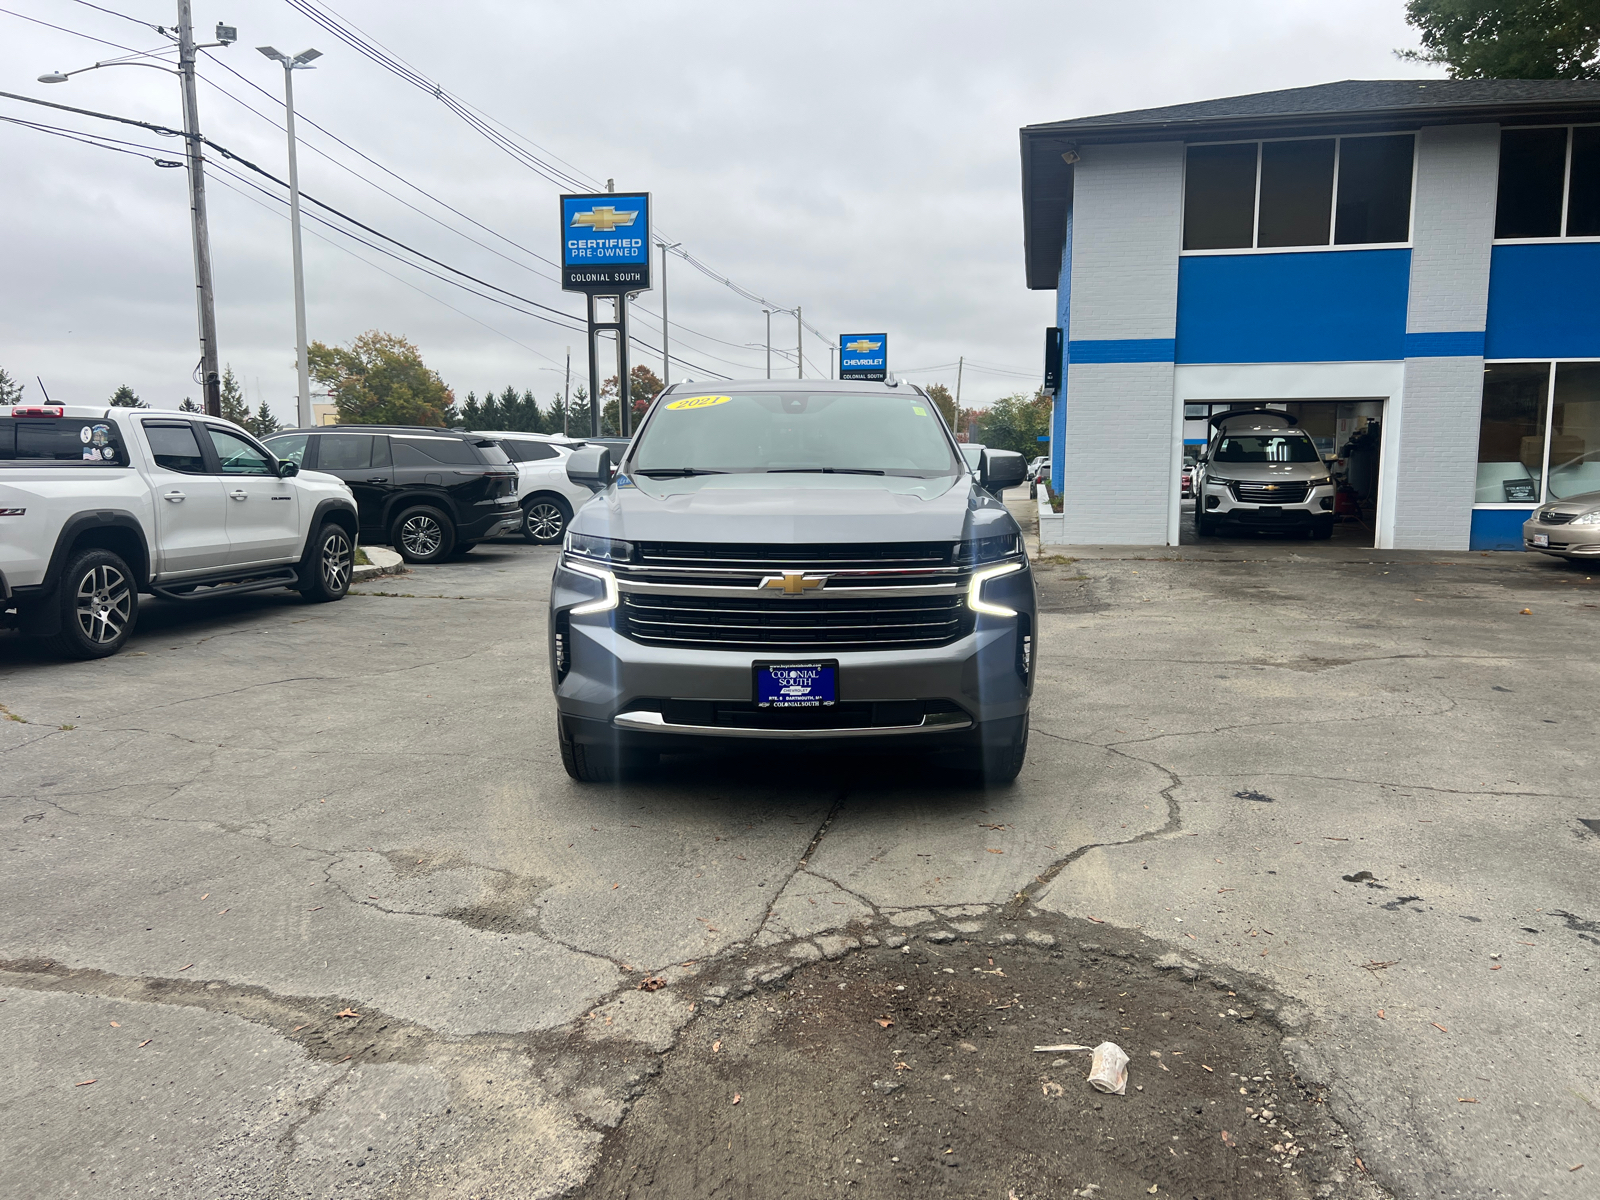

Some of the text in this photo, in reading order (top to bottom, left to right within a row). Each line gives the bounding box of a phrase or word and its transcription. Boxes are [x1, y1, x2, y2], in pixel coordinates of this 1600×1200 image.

[568, 239, 642, 249] CERTIFIED
[571, 248, 639, 257] PRE-OWNED
[570, 273, 641, 282] COLONIAL SOUTH
[843, 358, 883, 366] CHEVROLET
[675, 396, 721, 409] 2021
[771, 670, 819, 678] COLONIAL
[779, 678, 812, 686] SOUTH
